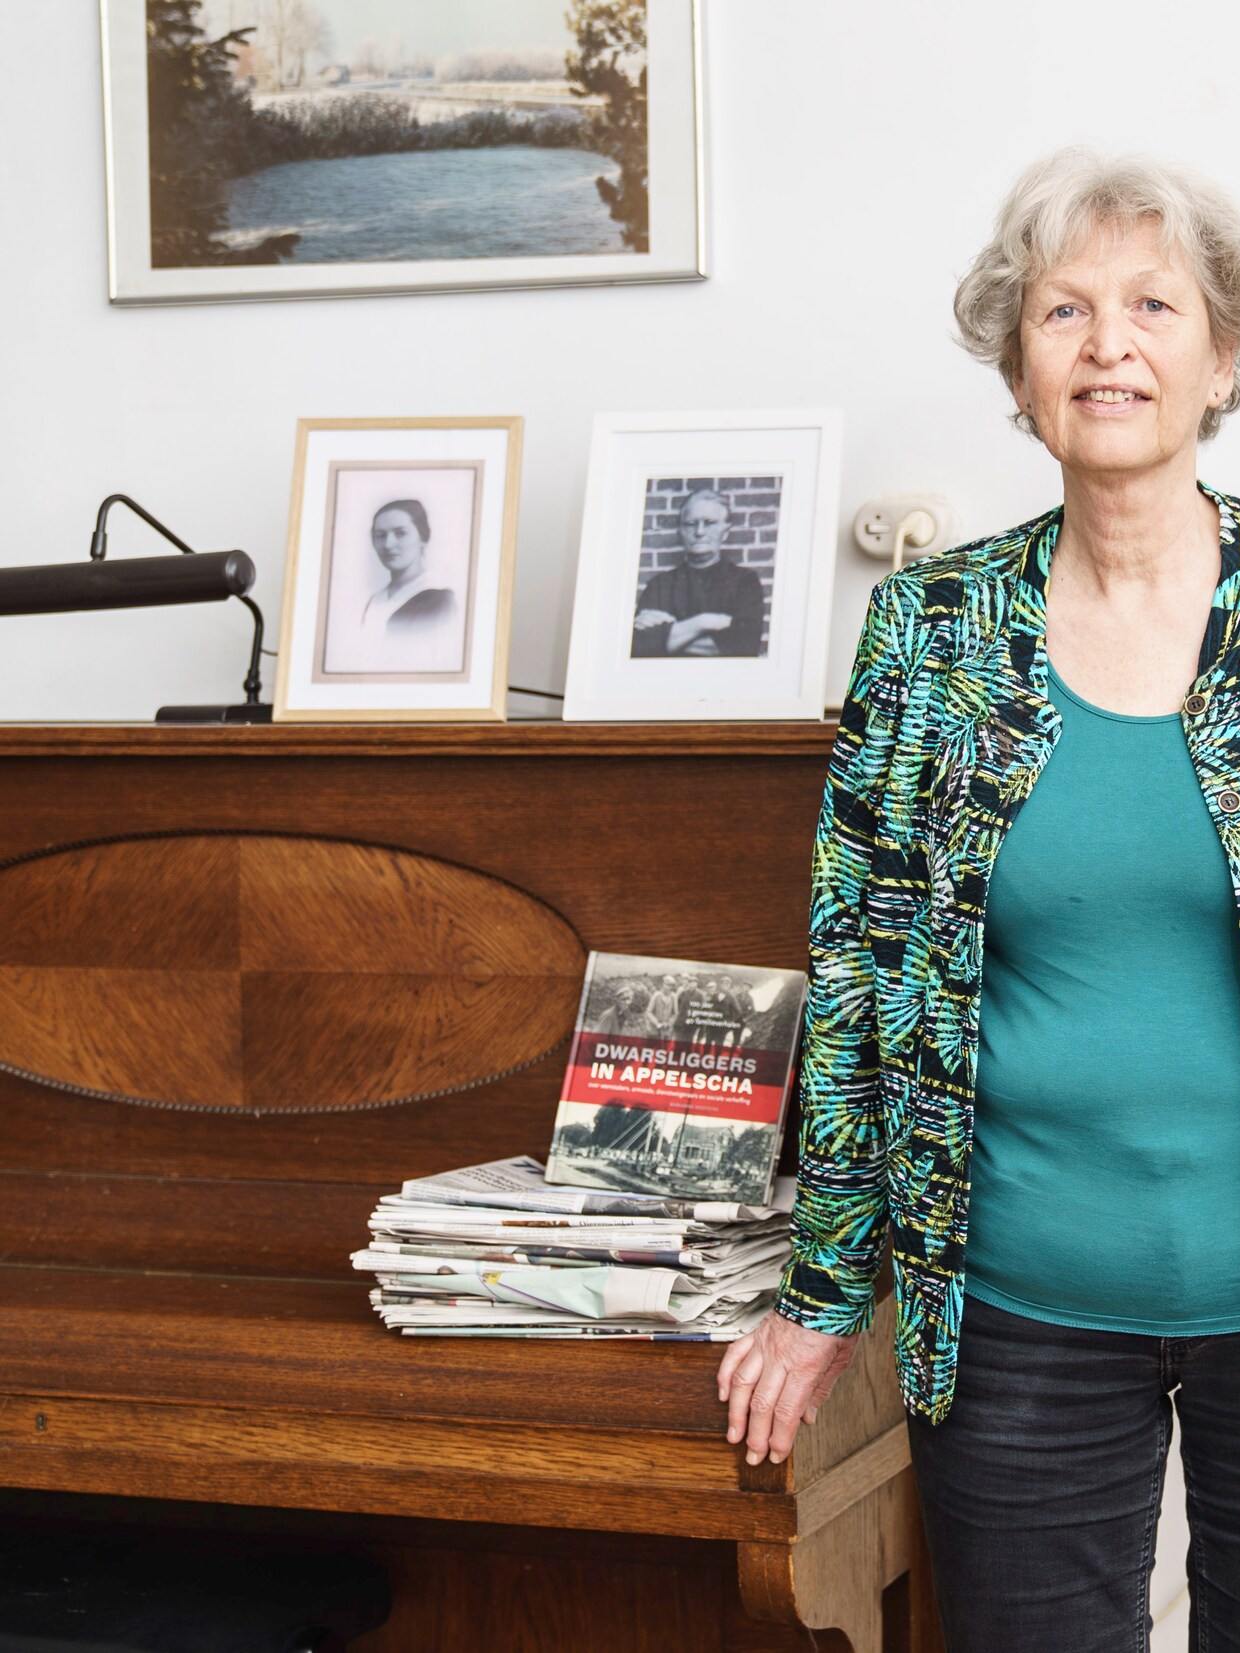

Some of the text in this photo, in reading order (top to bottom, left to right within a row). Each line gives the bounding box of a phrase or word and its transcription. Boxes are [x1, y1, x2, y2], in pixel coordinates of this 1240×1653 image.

[691, 1010, 723, 1018] generaties
[695, 1017, 741, 1028] familieverhalen
[595, 1043, 757, 1073] DWARSLIGGERS
[591, 1062, 753, 1094] IN APPELSCHA
